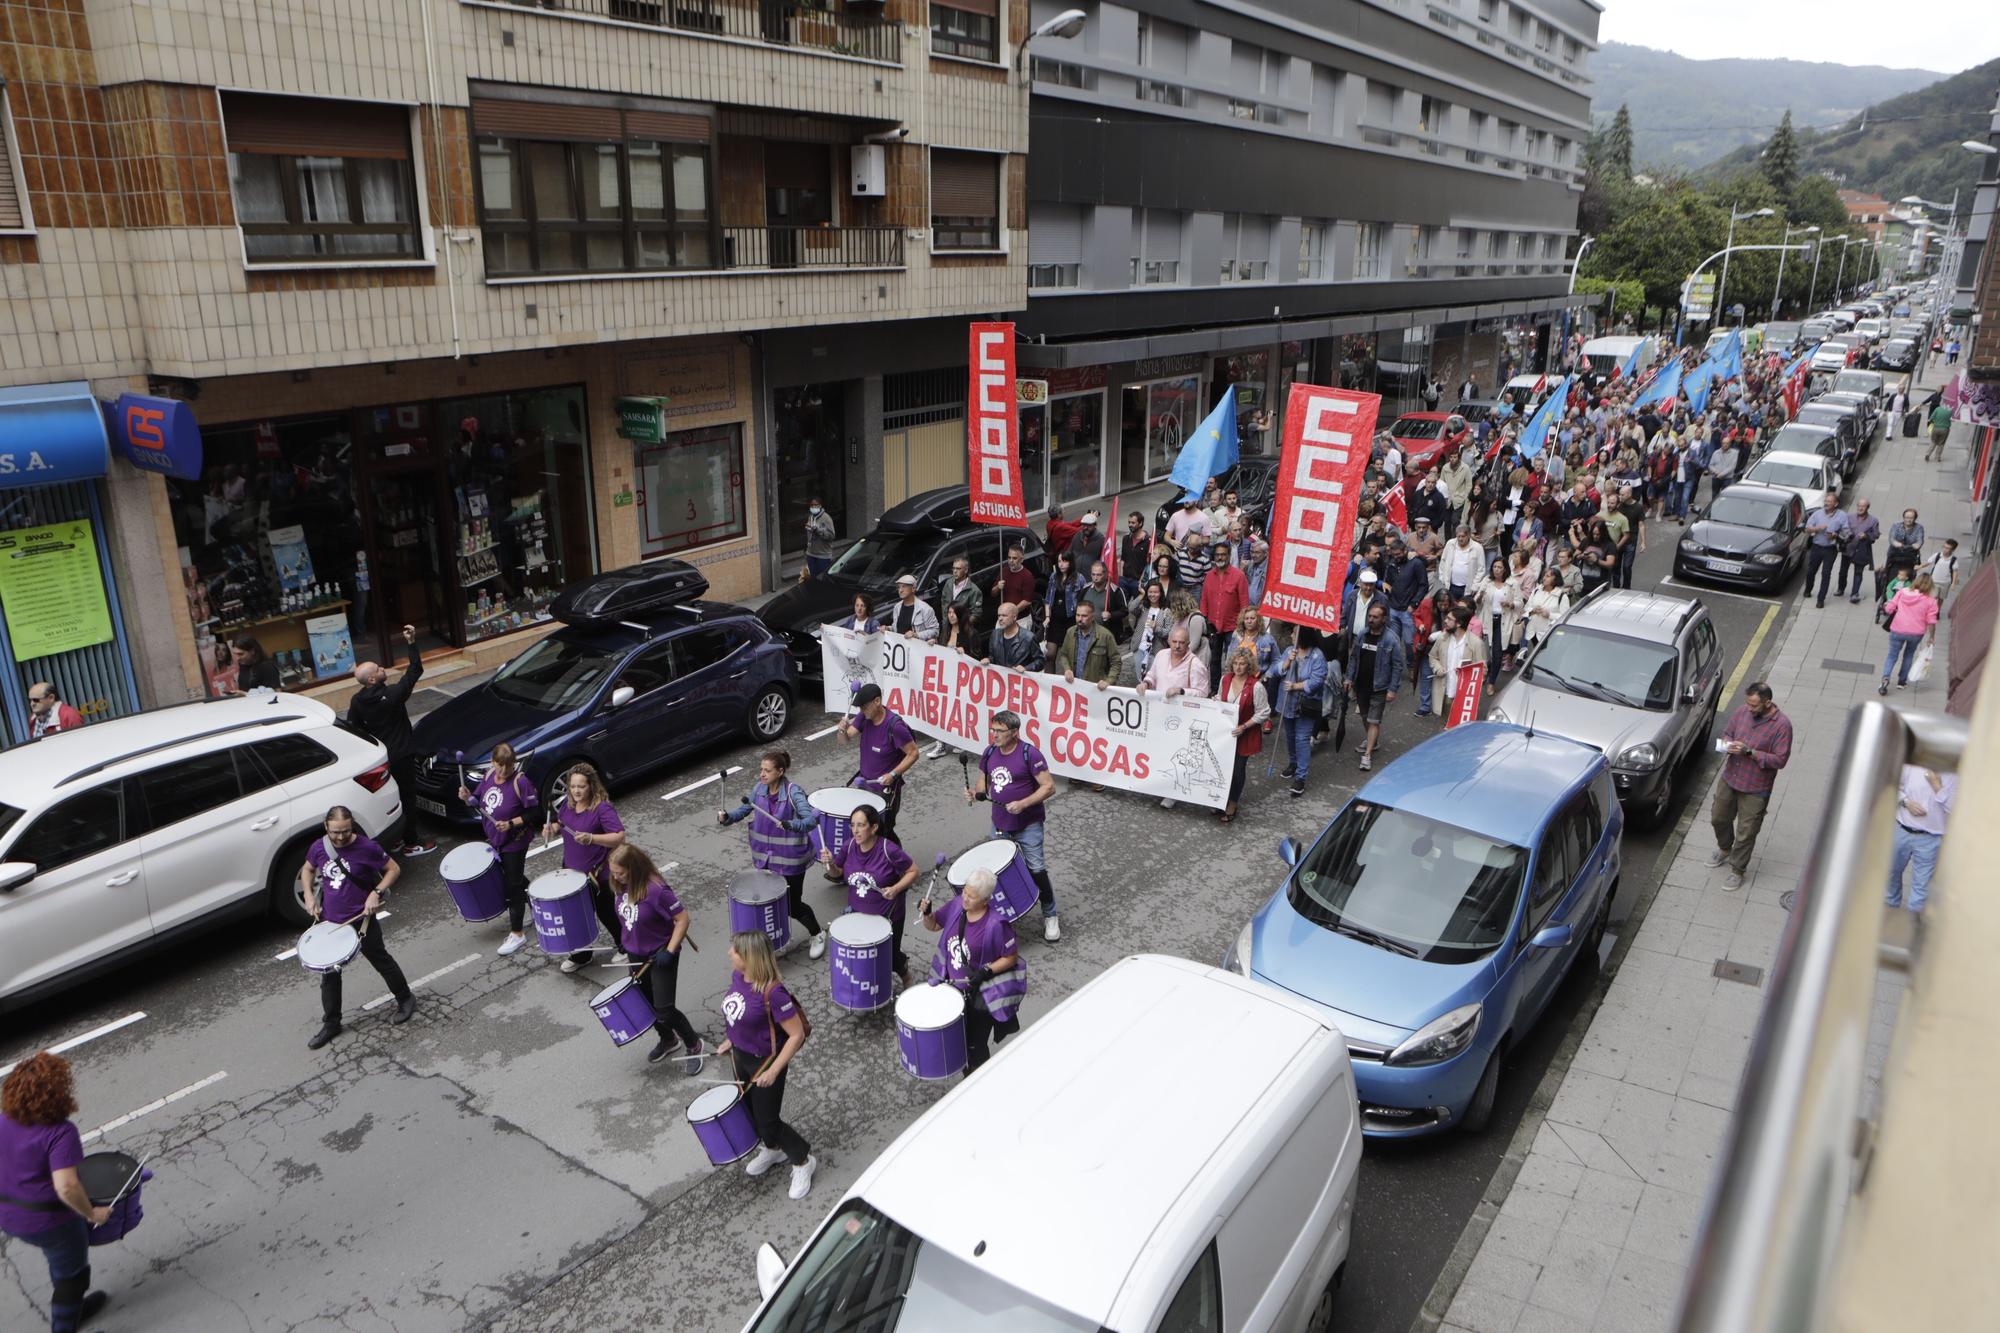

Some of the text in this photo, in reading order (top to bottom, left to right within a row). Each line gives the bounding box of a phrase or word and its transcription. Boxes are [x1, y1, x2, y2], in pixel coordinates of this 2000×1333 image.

[979, 332, 1011, 497] CCOO
[972, 500, 1023, 520] ASTURIAS
[1280, 395, 1359, 593] CCOO
[1262, 590, 1335, 622] ASTURIAS
[922, 655, 1089, 730] EL PODER DE
[1107, 696, 1142, 730] 60
[882, 687, 1150, 780] AMBIAR LS COSAS
[837, 947, 878, 959] CCOO
[835, 958, 879, 996] NALON
